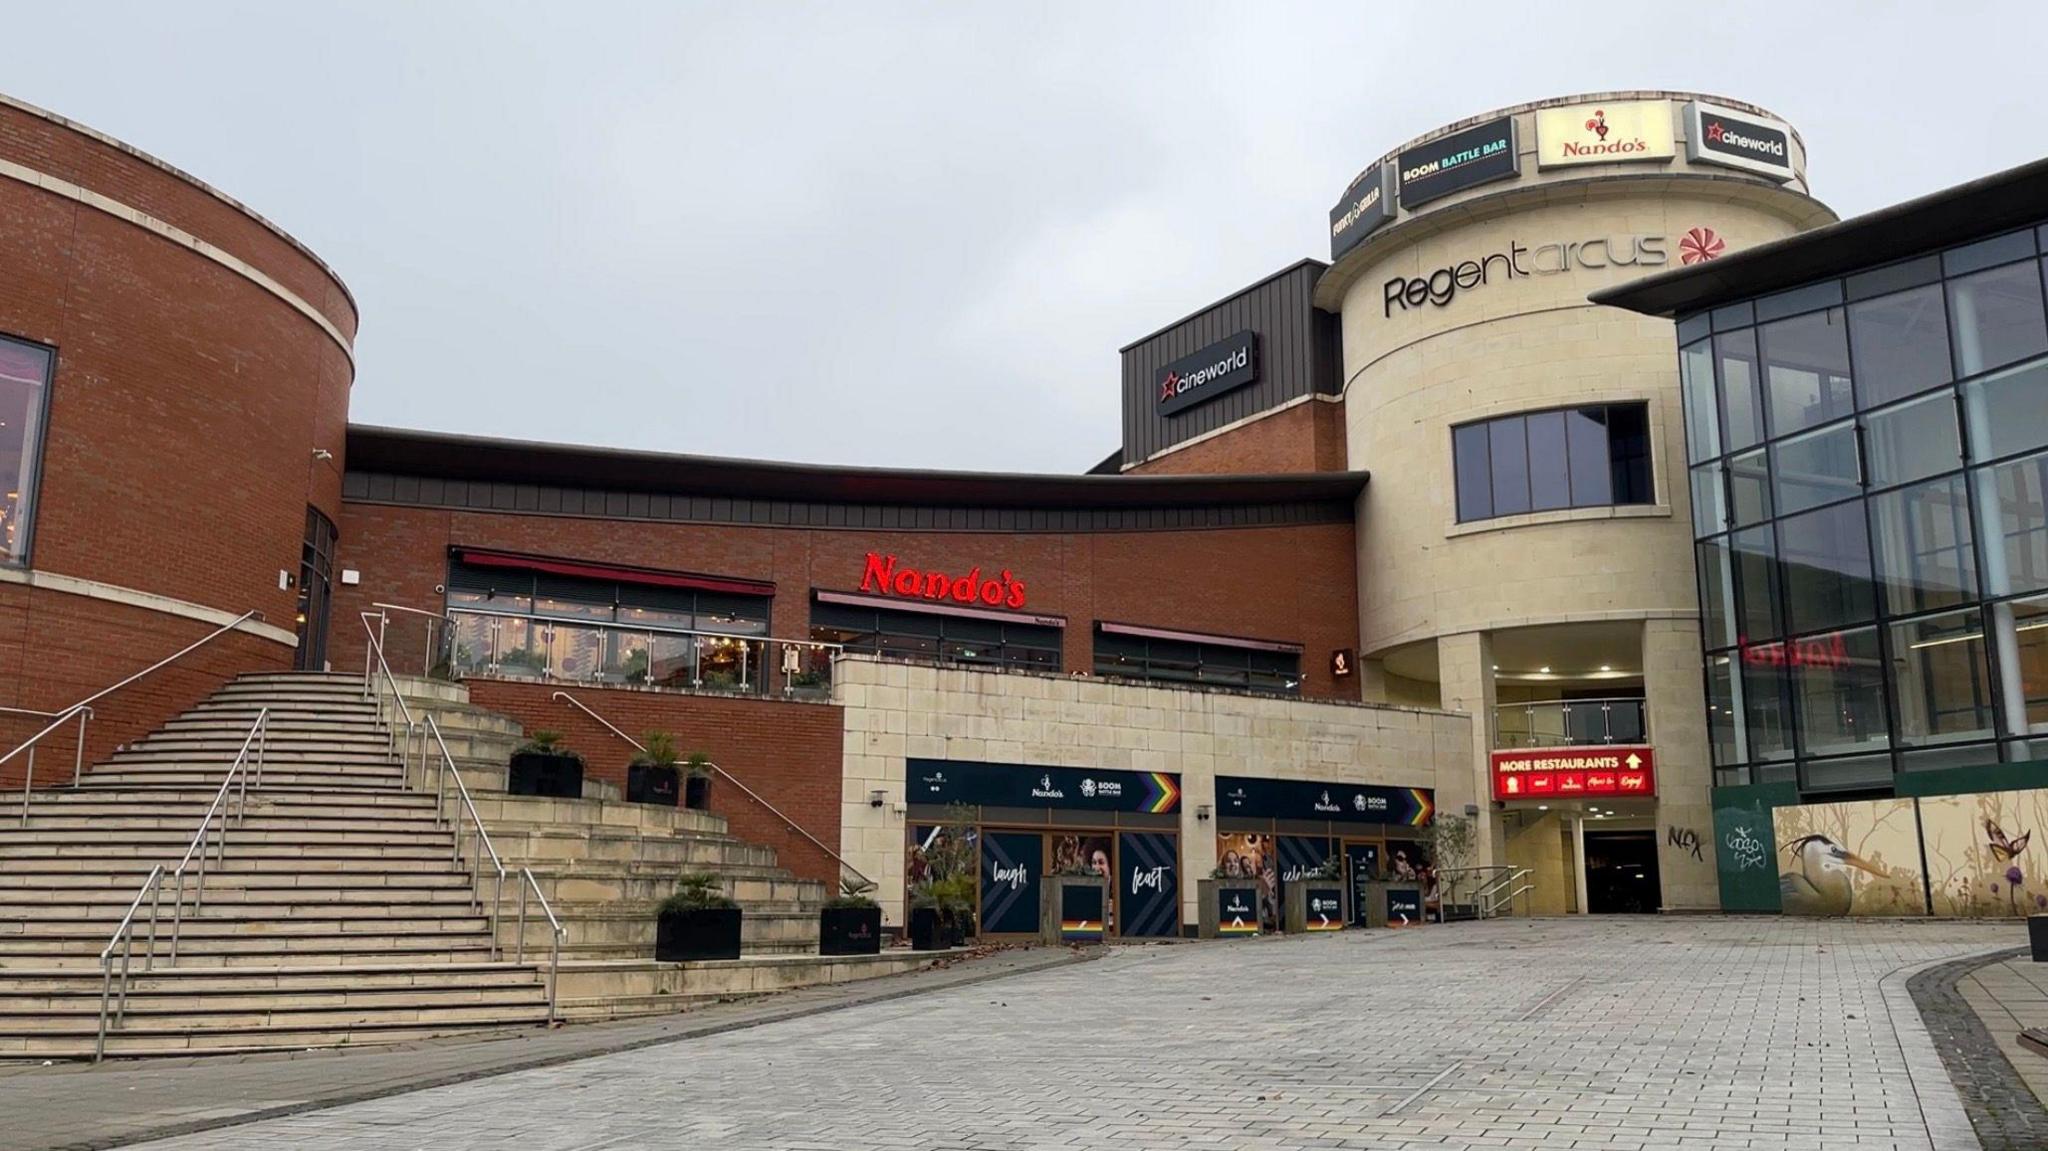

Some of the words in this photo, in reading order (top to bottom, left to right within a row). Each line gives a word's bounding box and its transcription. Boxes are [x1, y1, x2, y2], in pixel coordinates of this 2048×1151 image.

[1562, 137, 1647, 157] Nando's
[1722, 131, 1784, 156] cineworld
[1403, 161, 1439, 182] BOOM
[1441, 147, 1480, 169] BATTLE
[1482, 139, 1507, 155] BAR
[1176, 345, 1248, 393] cineworld
[858, 551, 1027, 609] Nando's
[1499, 760, 1532, 773] MORE
[1533, 756, 1620, 771] RESTAURANTS
[993, 860, 1028, 890] laugh
[1132, 866, 1171, 895] feast
